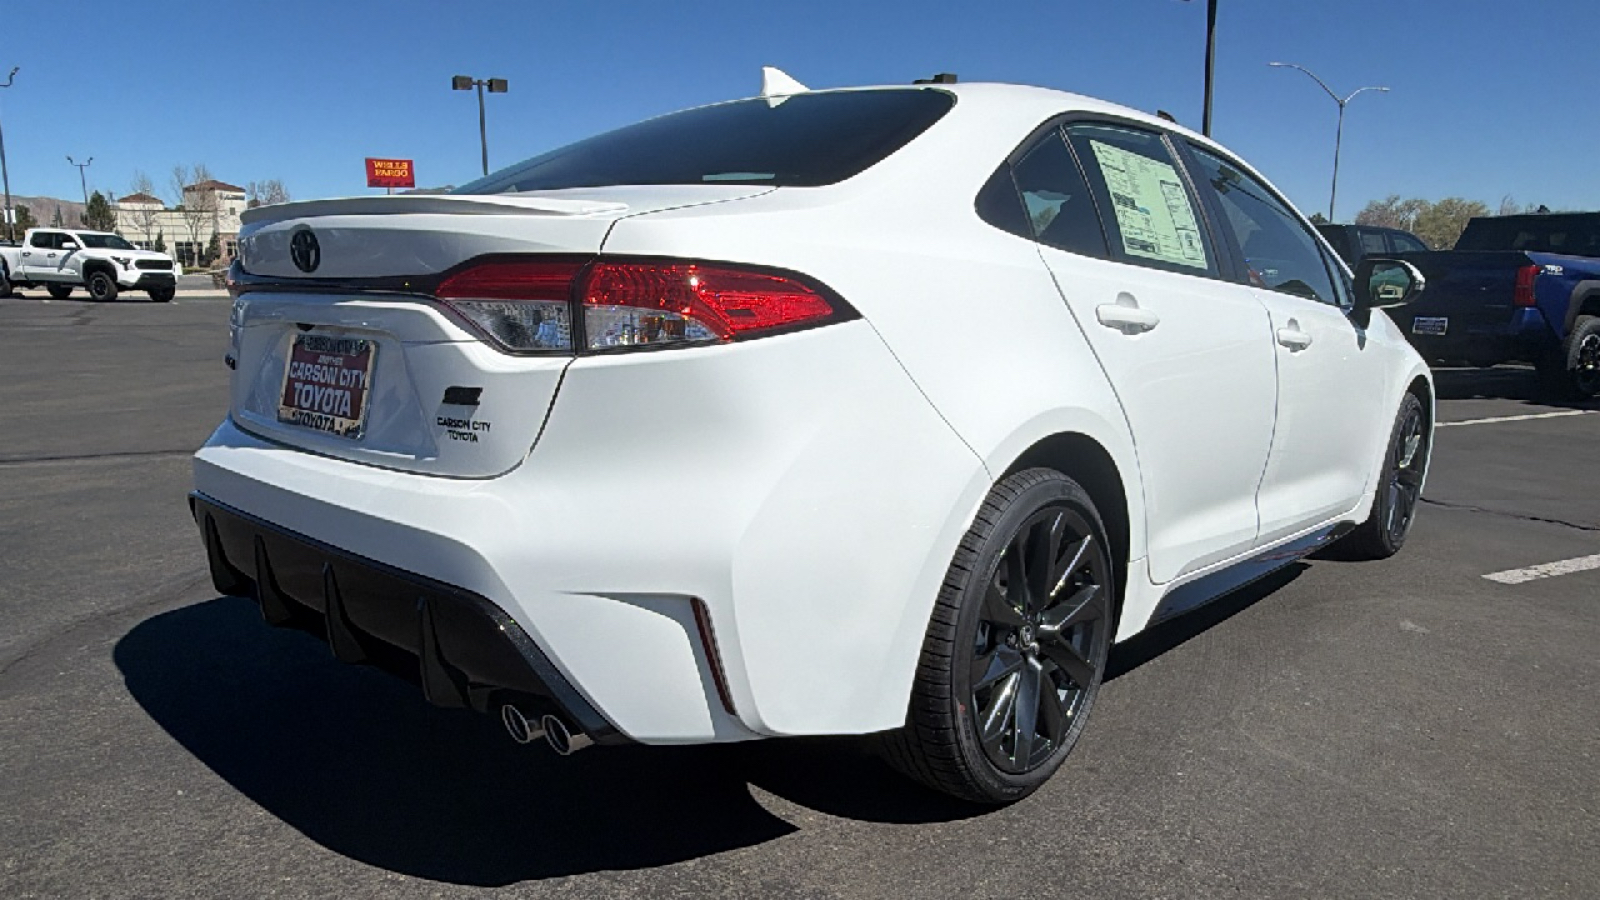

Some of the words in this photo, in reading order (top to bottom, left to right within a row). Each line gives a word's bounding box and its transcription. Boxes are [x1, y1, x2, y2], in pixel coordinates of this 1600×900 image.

[372, 160, 408, 169] WELLS
[374, 169, 409, 177] FARGO
[290, 361, 338, 385] CARSON
[340, 368, 366, 389] CITY
[294, 382, 351, 417] TOYOTA
[298, 411, 336, 432] TOYOTA
[437, 416, 470, 430] CARSON
[472, 420, 491, 432] CITY
[447, 429, 478, 443] TOYOTA
